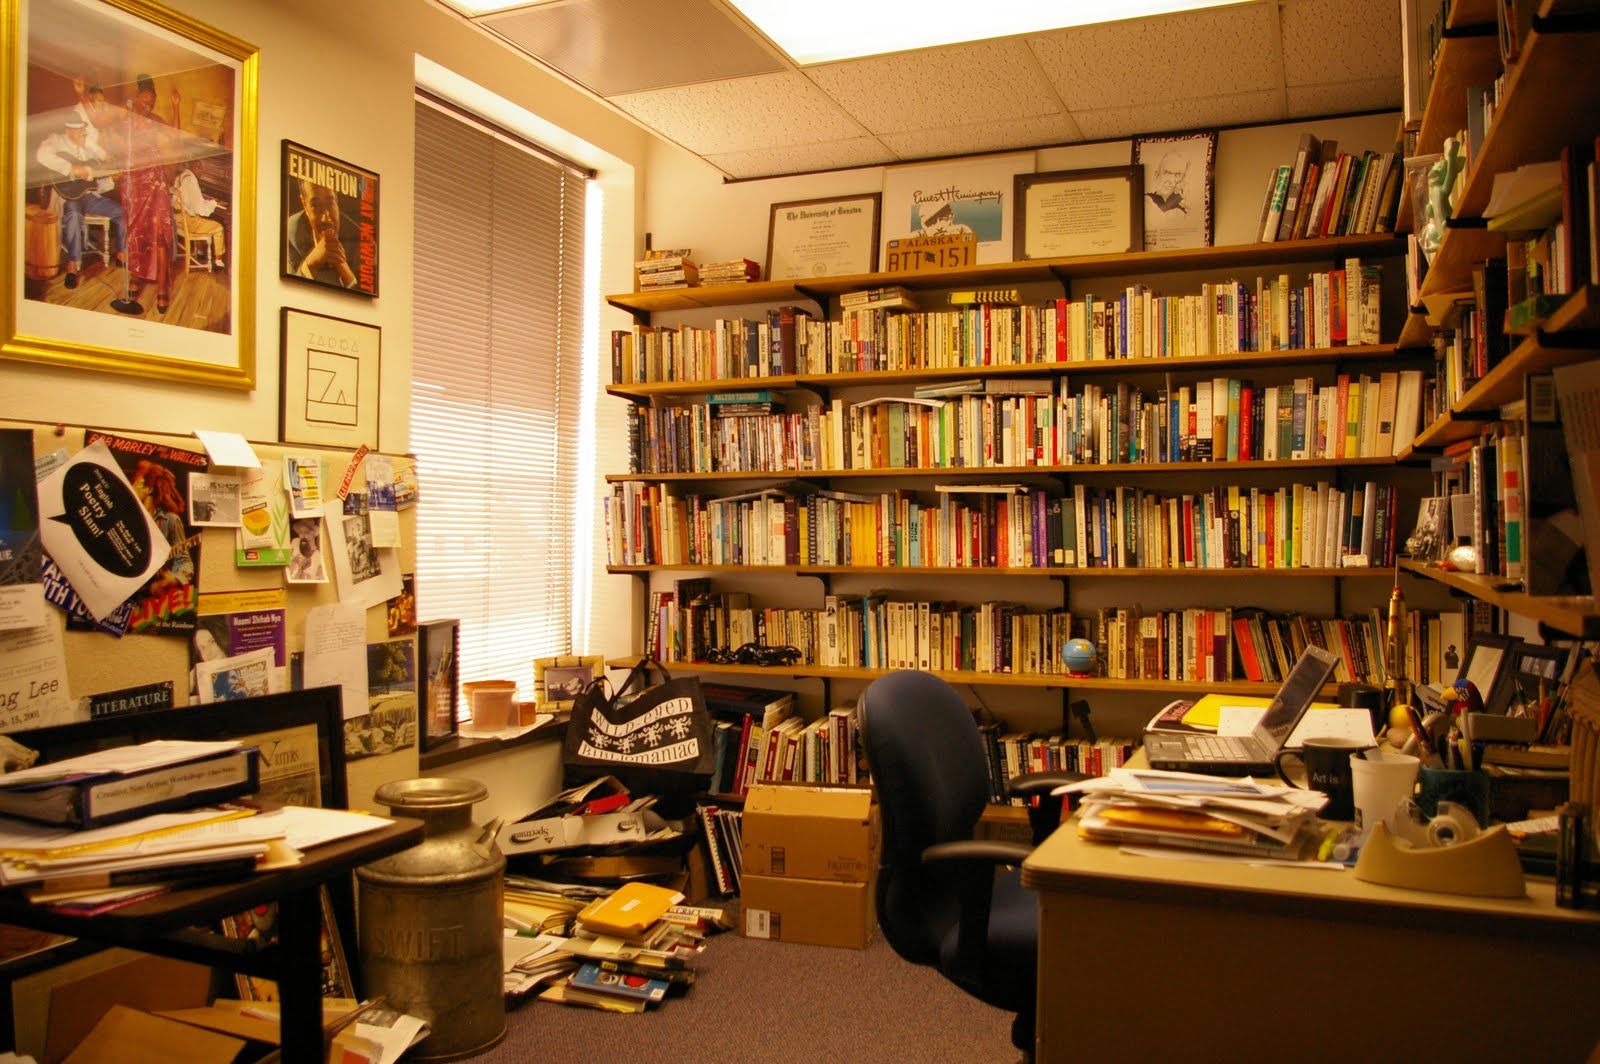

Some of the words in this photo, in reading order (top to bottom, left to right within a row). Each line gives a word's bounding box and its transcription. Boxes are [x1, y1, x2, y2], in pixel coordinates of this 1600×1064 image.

[290, 153, 358, 198] ELLINGTON
[913, 190, 946, 203] Ernest
[947, 185, 1003, 205] Hemingway
[786, 211, 799, 220] The
[799, 208, 829, 220] University
[830, 208, 837, 216] of
[837, 206, 862, 215] Houston
[906, 236, 953, 248] ALASKA
[360, 221, 374, 293] NEWPORT
[939, 246, 970, 268] 151
[90, 433, 113, 447] BB
[111, 438, 155, 456] MARLEY
[79, 482, 107, 519] Poetry
[94, 483, 115, 510] English
[78, 505, 104, 538] Slam!
[172, 621, 195, 630] Rainbow
[233, 616, 252, 627] Naomi
[271, 612, 282, 623] Nye
[28, 678, 60, 701] Lee
[91, 691, 170, 717] LITERATURE
[1312, 771, 1327, 784] Art
[1329, 774, 1339, 784] is
[513, 827, 550, 839] Spectrum
[374, 925, 464, 961] SWIFT
